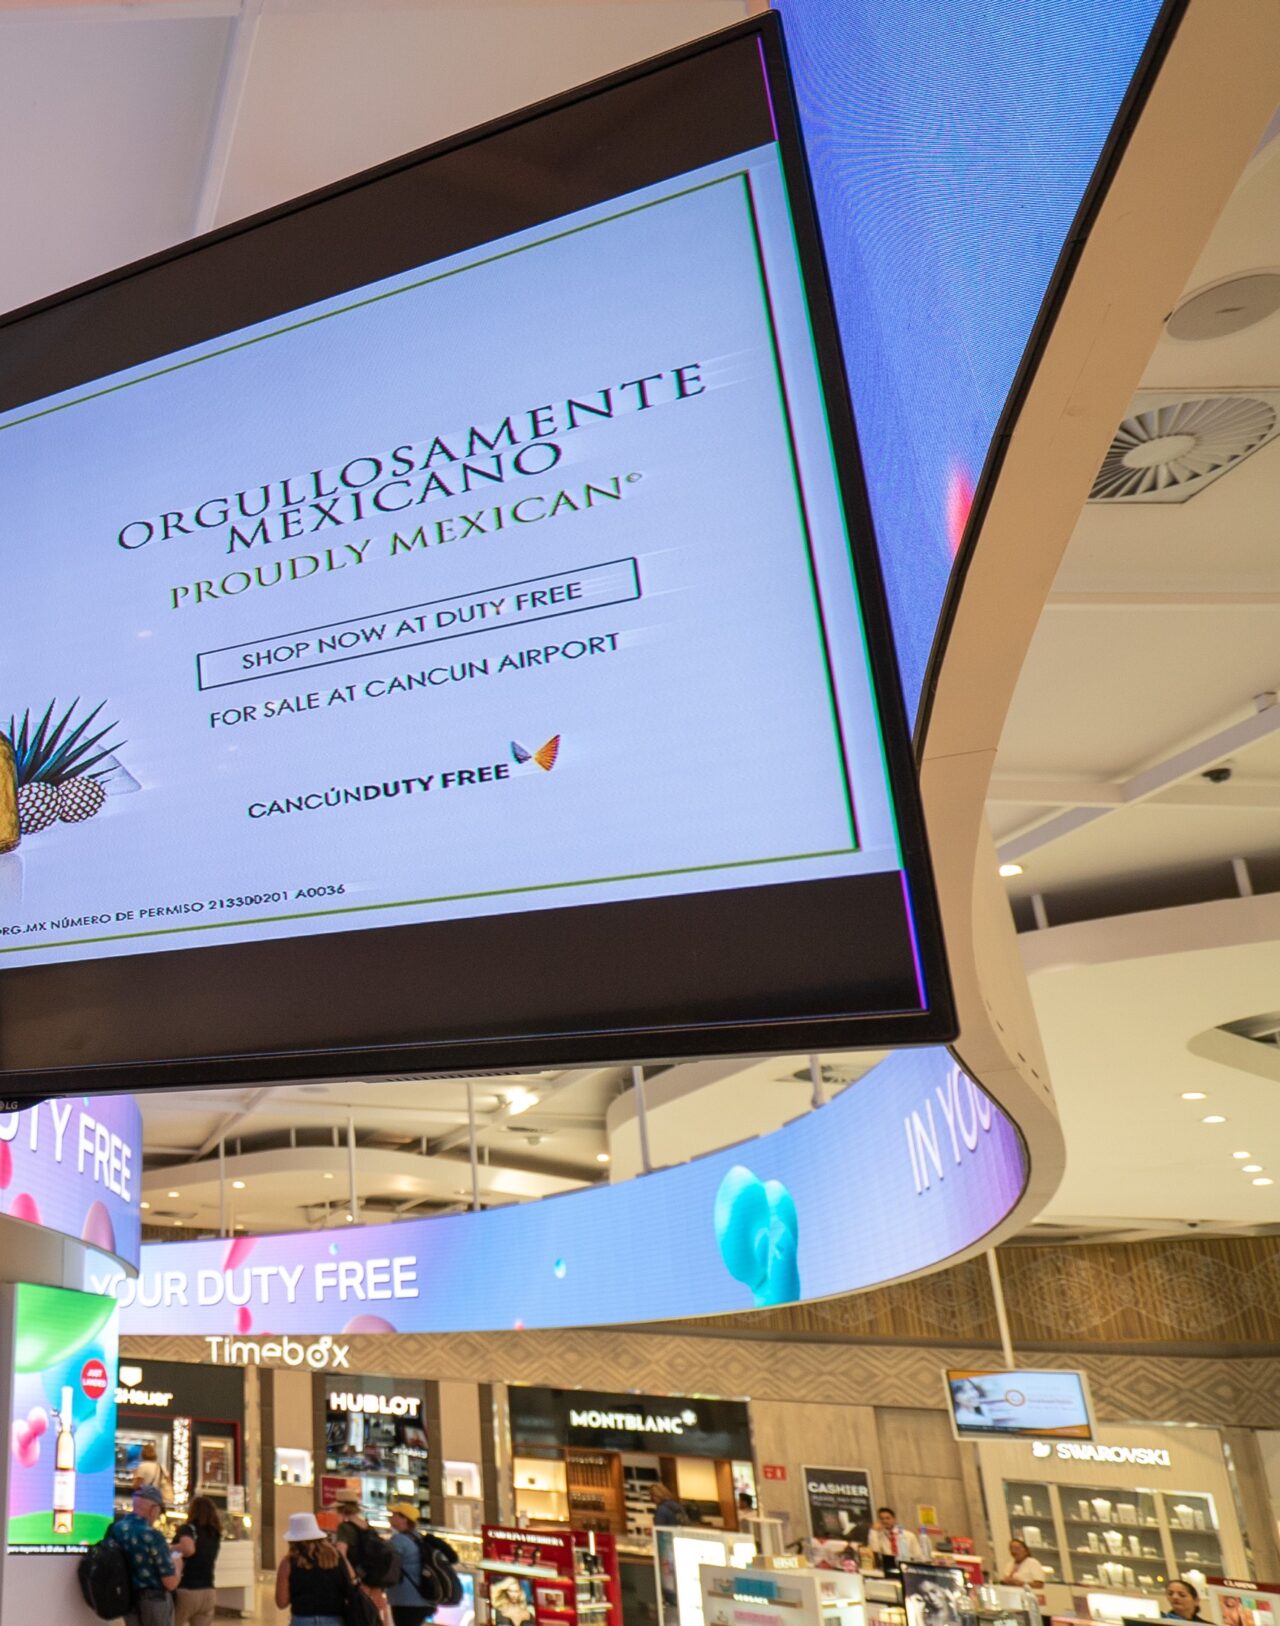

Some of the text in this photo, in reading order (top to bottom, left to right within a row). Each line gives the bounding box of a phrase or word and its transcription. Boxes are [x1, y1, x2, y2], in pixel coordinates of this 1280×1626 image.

[117, 362, 707, 551] ORGULLOSAMENTE
[226, 442, 562, 555] MEXICANO
[170, 537, 372, 609] PROUDLY
[242, 581, 583, 670] SHOP NOW AT DUTY FREE
[210, 632, 620, 729] FOR SALE AT CANCUN AIRPORT
[441, 763, 510, 789] FREE
[49, 911, 112, 932] NÚMERO
[114, 910, 135, 923] DE
[139, 901, 205, 920] PERMISO
[294, 883, 347, 902] A0036
[904, 1061, 991, 1194] IN YOU
[78, 1112, 132, 1203] FREE
[89, 1256, 419, 1308] YOUR DUTY FREE
[205, 1335, 351, 1368] Timebox
[329, 1391, 420, 1417] HUBLOT
[569, 1408, 684, 1435] MONTBLANC
[1055, 1443, 1172, 1467] SWAROVSKI
[807, 1481, 870, 1497] CASHIER
